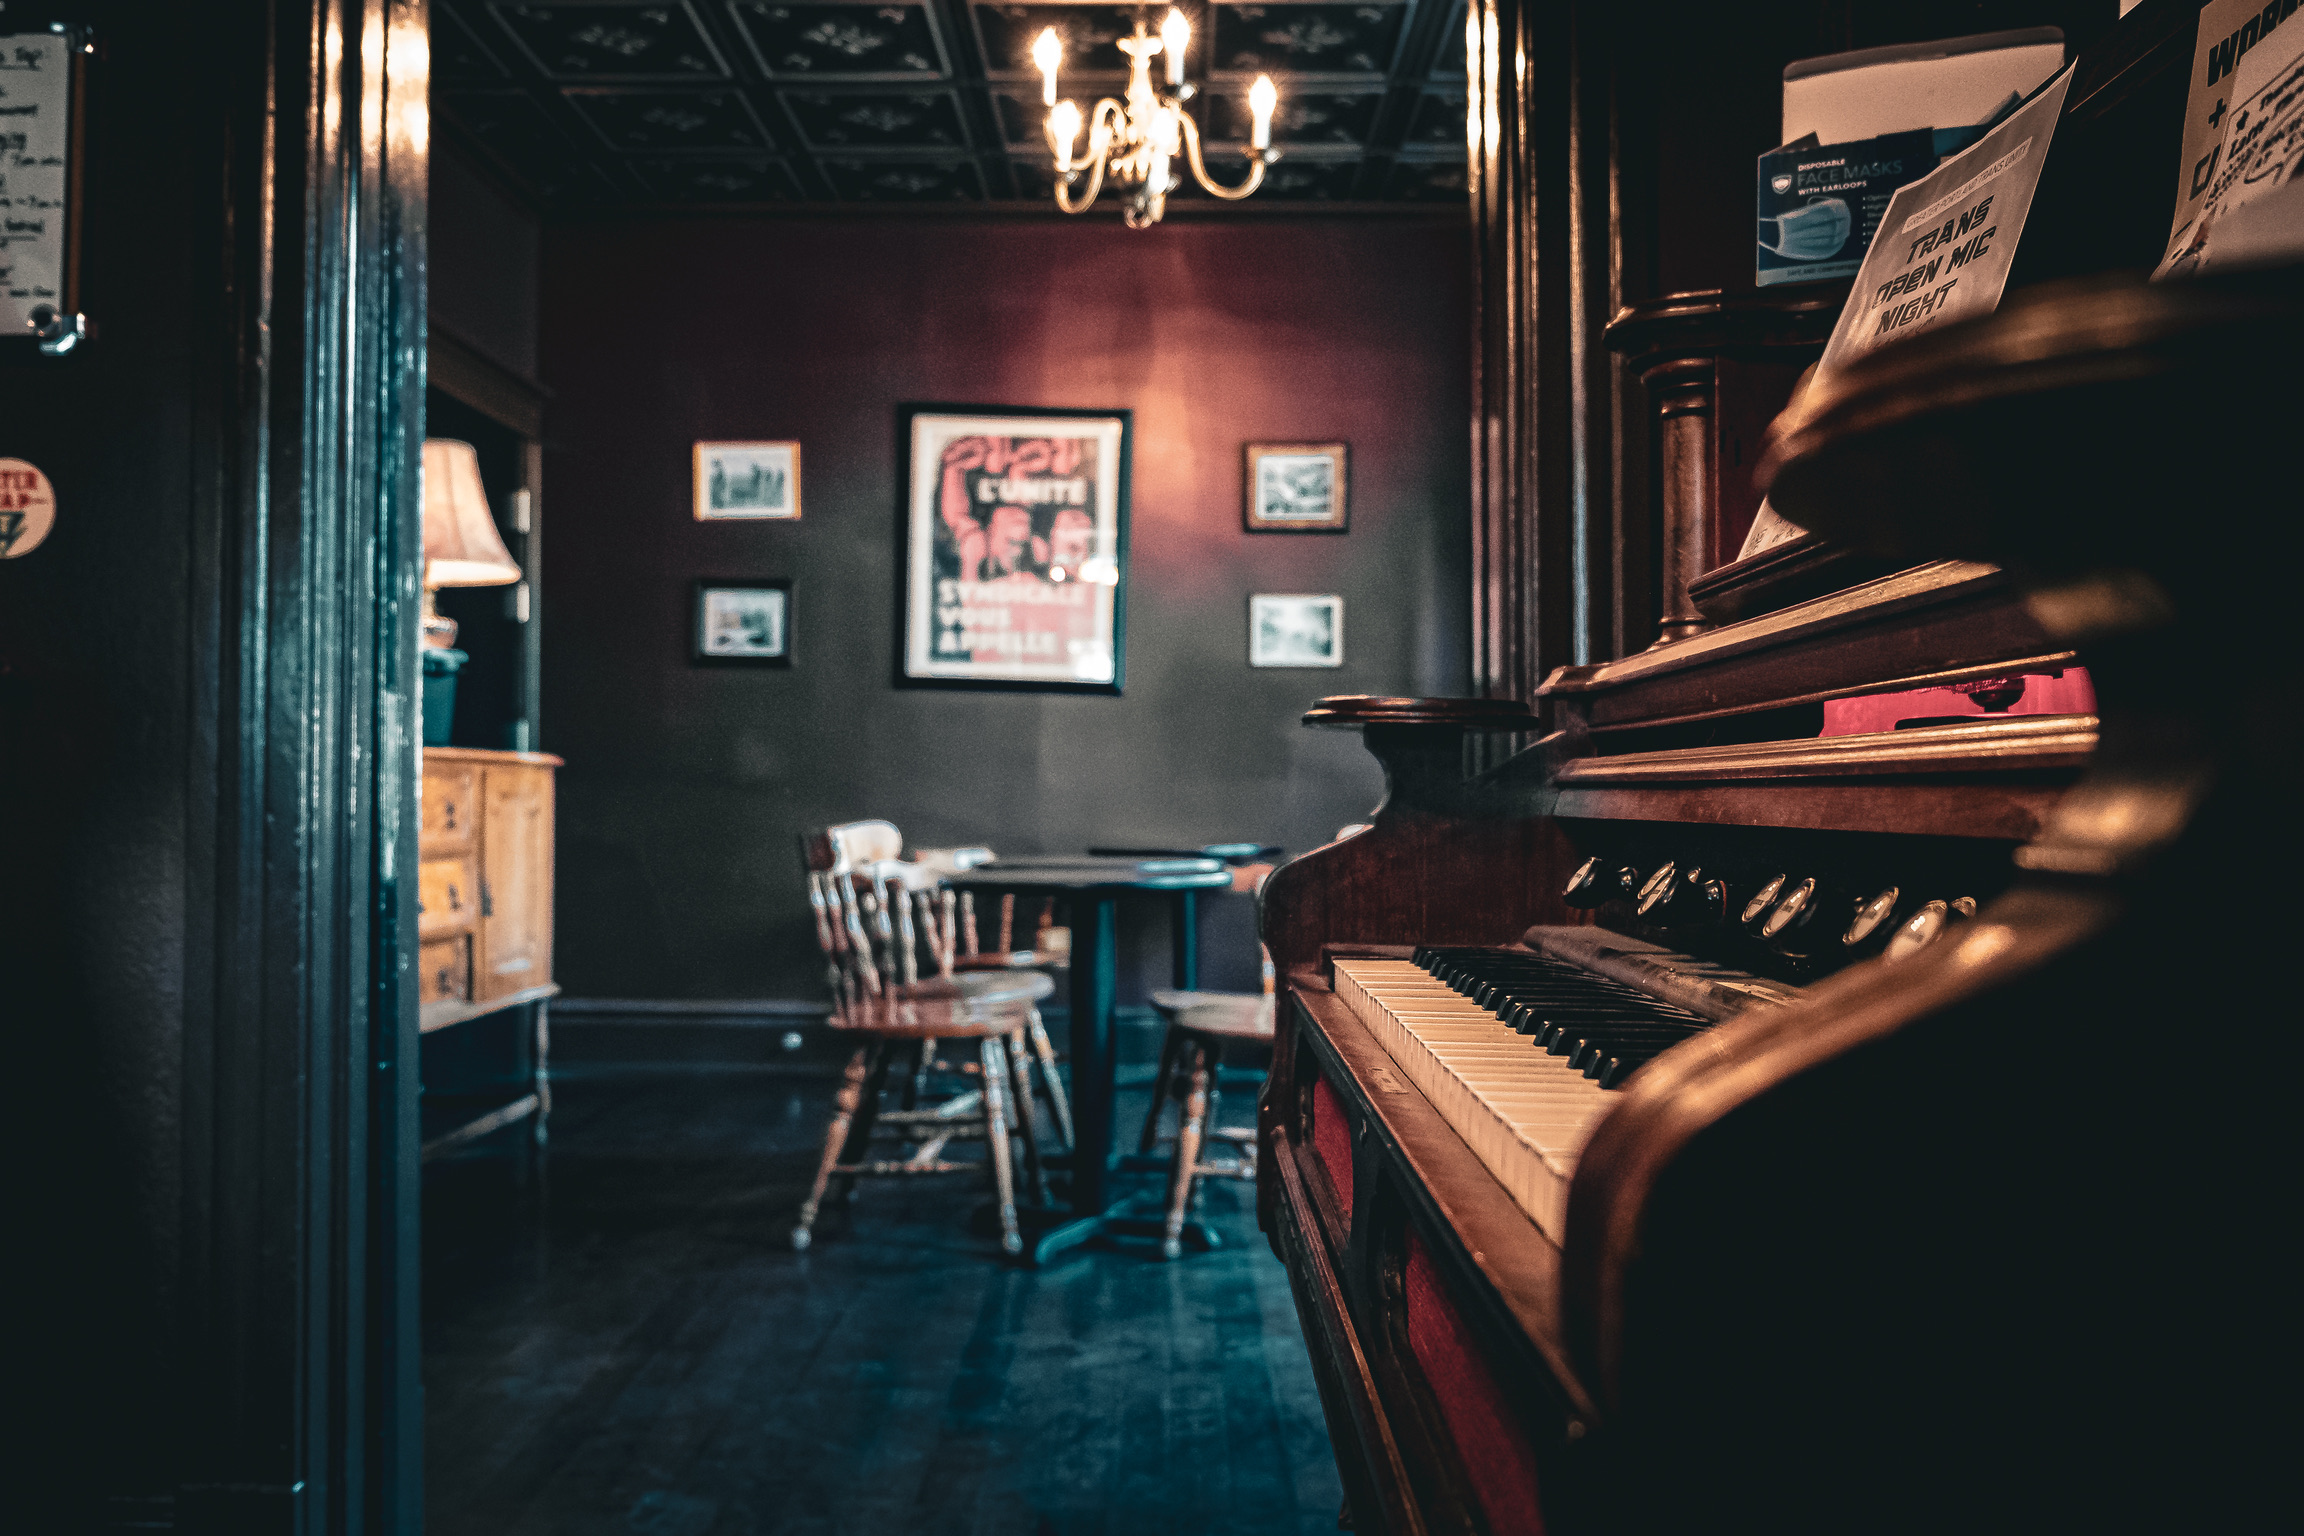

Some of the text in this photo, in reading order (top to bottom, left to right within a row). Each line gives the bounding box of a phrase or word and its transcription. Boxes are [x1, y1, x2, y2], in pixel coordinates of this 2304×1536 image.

[1797, 157, 1846, 172] DISPOSABLE
[1797, 159, 1903, 187] FACE MASKS
[1979, 161, 2004, 183] TRANS
[1798, 180, 1868, 196] WITH EARLOOPS
[1906, 194, 1995, 265] TRANS
[1872, 225, 1997, 309] OPEN MIC
[1874, 278, 1958, 337] NIGHT
